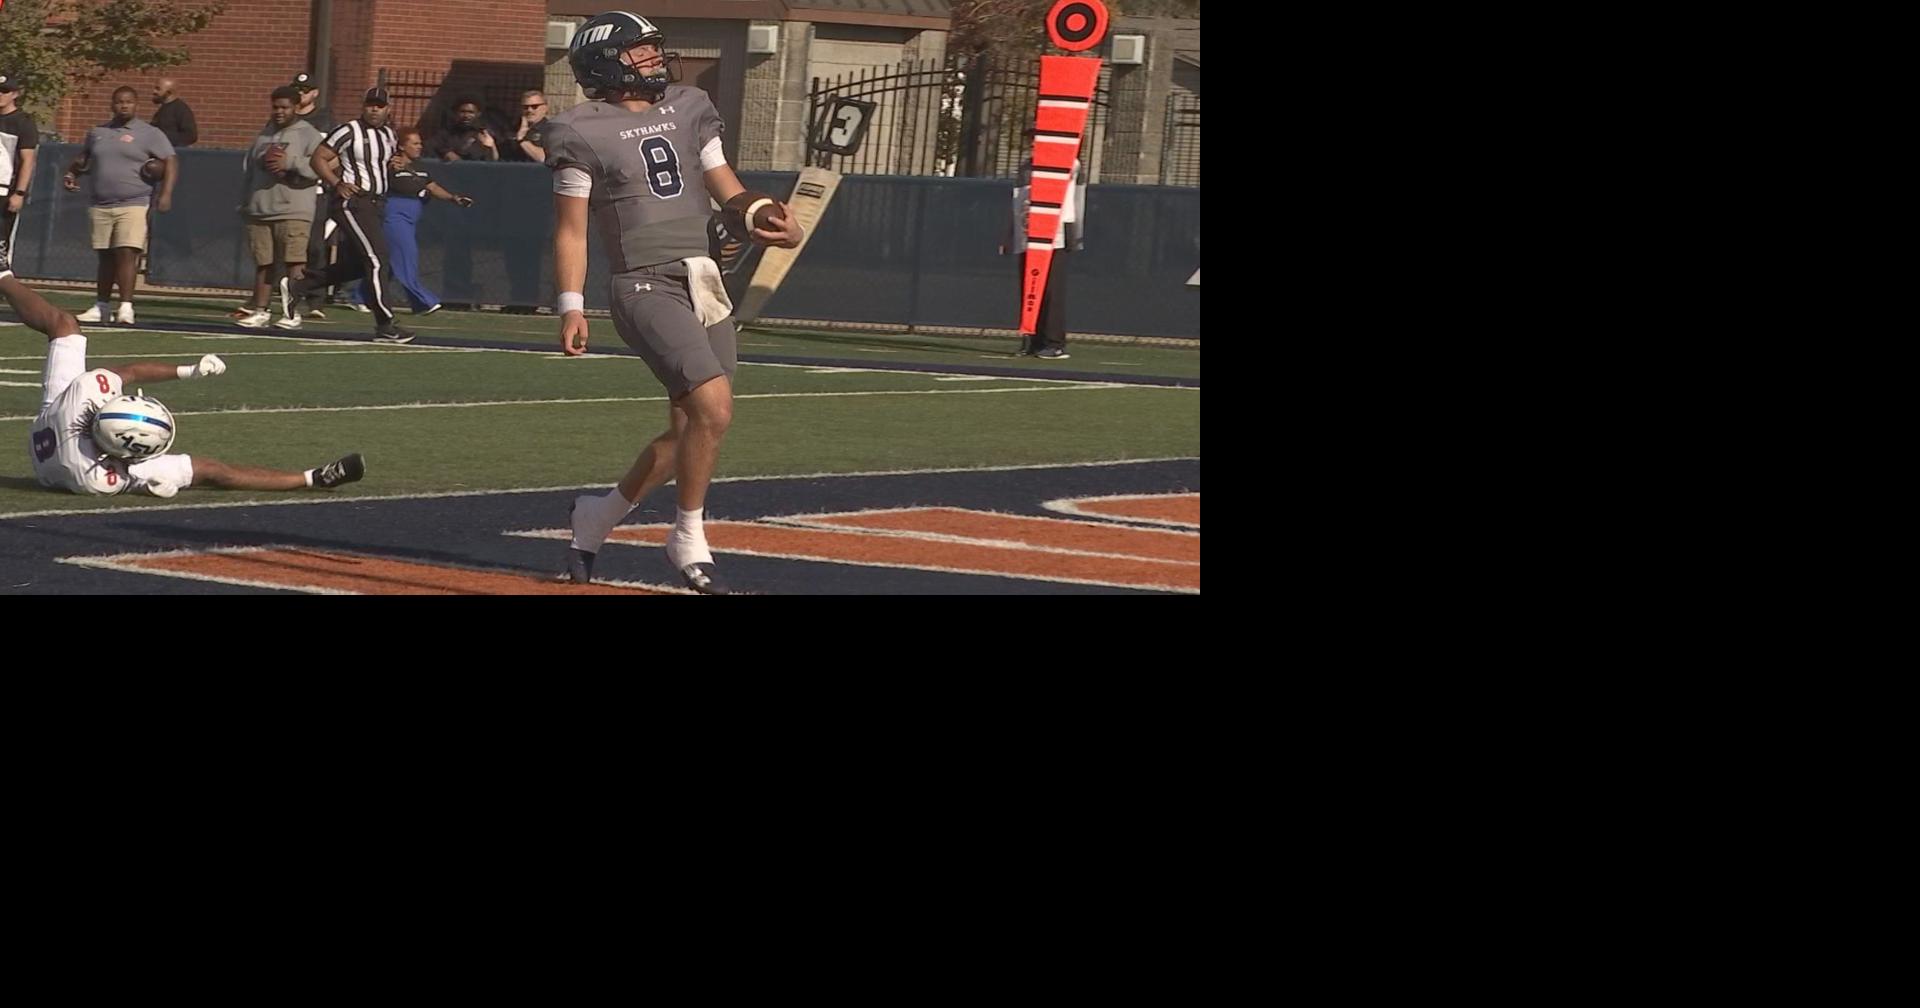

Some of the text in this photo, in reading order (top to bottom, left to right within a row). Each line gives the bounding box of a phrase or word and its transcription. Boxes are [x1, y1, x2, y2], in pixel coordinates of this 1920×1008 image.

[620, 122, 676, 139] SKYHAWKS
[830, 105, 863, 147] 3
[639, 135, 684, 199] 8
[96, 374, 110, 394] 8
